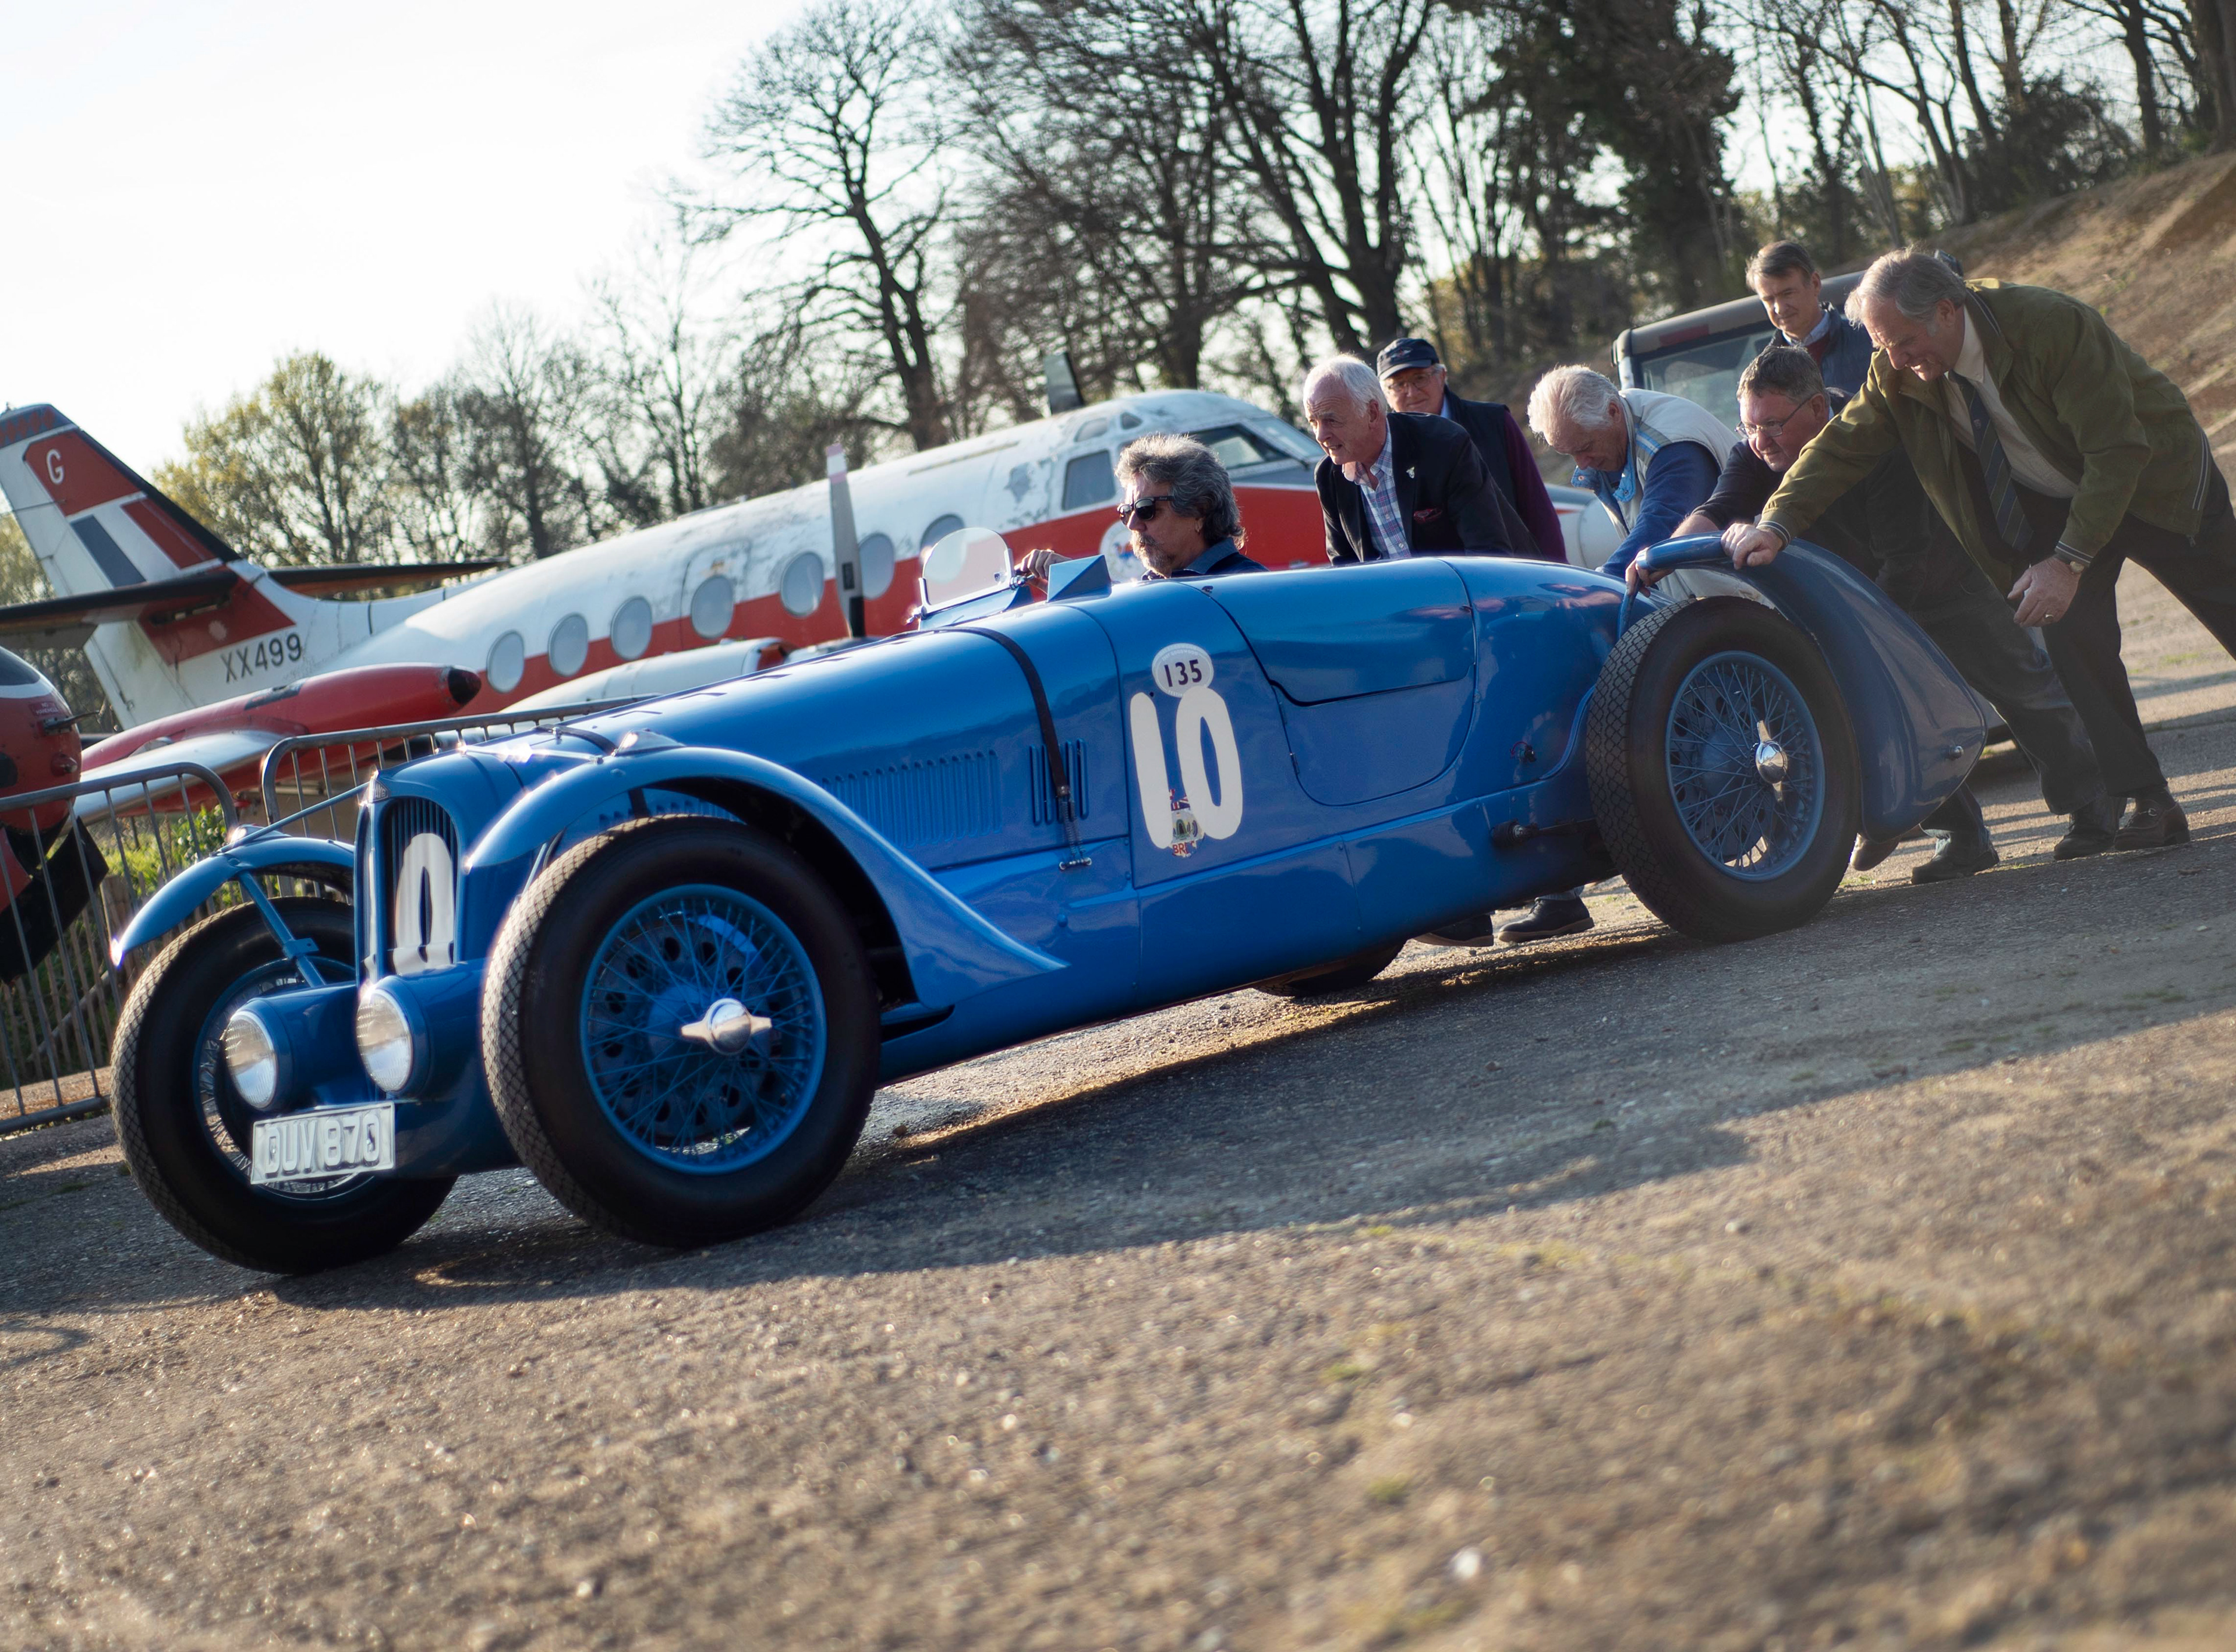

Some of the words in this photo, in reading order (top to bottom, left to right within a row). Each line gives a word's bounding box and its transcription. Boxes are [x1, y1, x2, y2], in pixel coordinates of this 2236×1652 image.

[46, 448, 64, 484] G
[221, 633, 301, 684] XX499
[1164, 659, 1202, 687] 135
[1130, 685, 1243, 849] 10
[265, 1119, 319, 1175] DUV
[324, 1112, 380, 1167] 870
